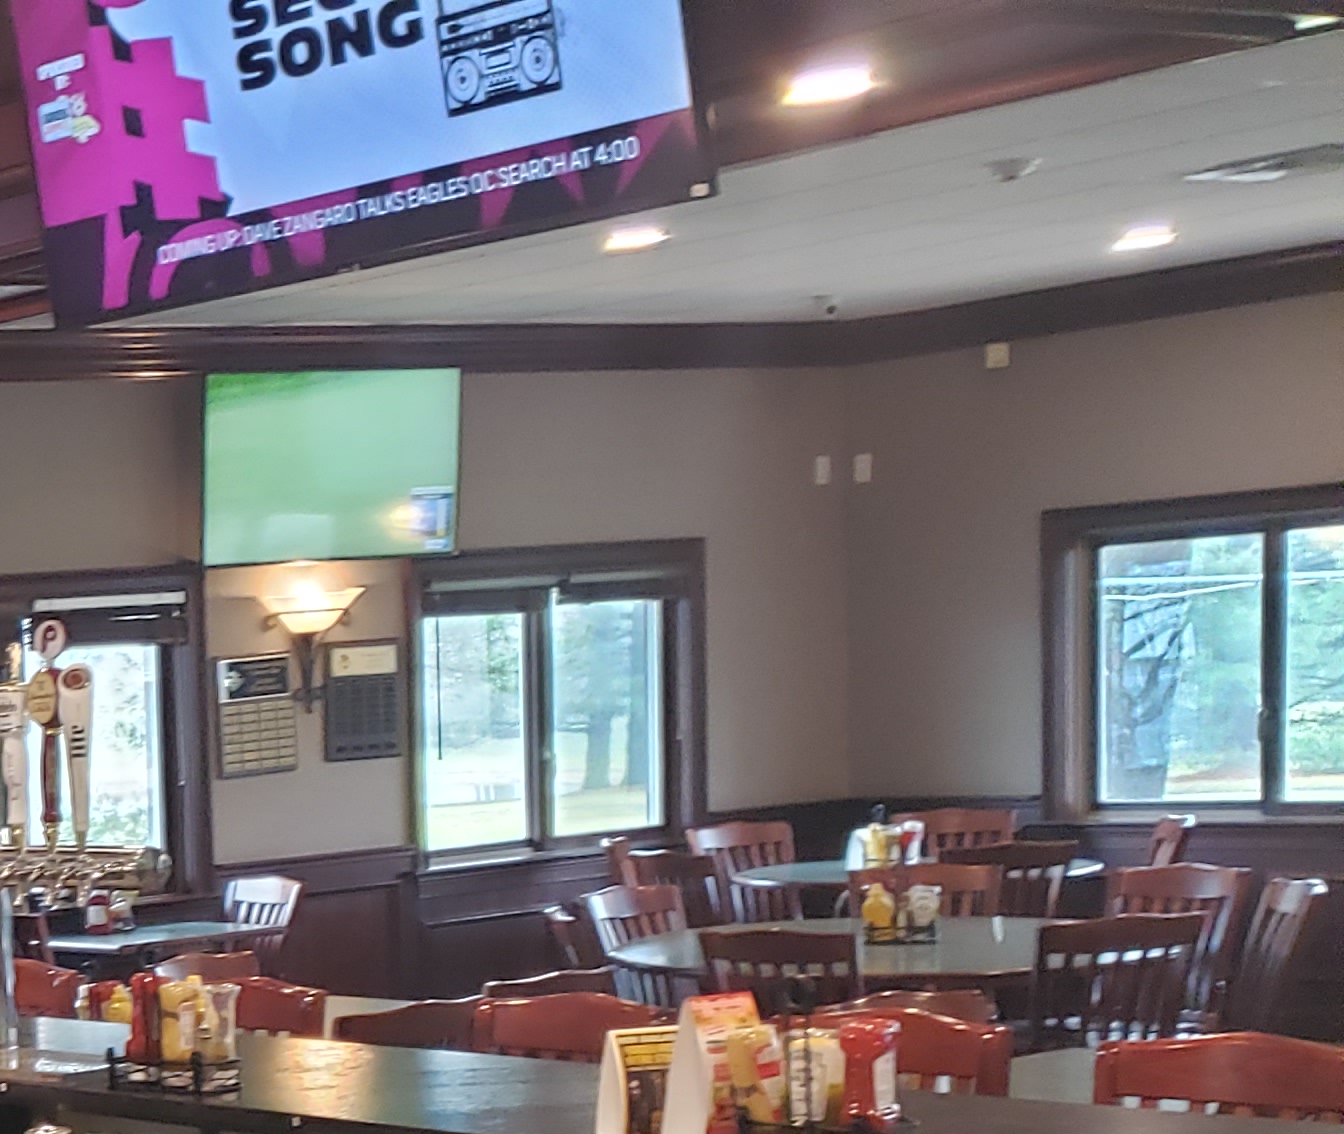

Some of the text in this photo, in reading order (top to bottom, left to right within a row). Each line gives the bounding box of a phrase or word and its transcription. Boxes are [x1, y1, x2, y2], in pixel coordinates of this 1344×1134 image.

[227, 0, 357, 39] SE
[235, 2, 424, 91] SONG
[158, 236, 217, 264] COMING
[244, 219, 280, 244] DAVE
[281, 200, 355, 237] ZANGARO
[355, 192, 404, 220] TALKS
[406, 175, 470, 208] EAGLES
[471, 171, 495, 194] OC
[499, 154, 566, 188] SEARCH
[568, 146, 593, 171] AT
[593, 135, 641, 165] 4:00
